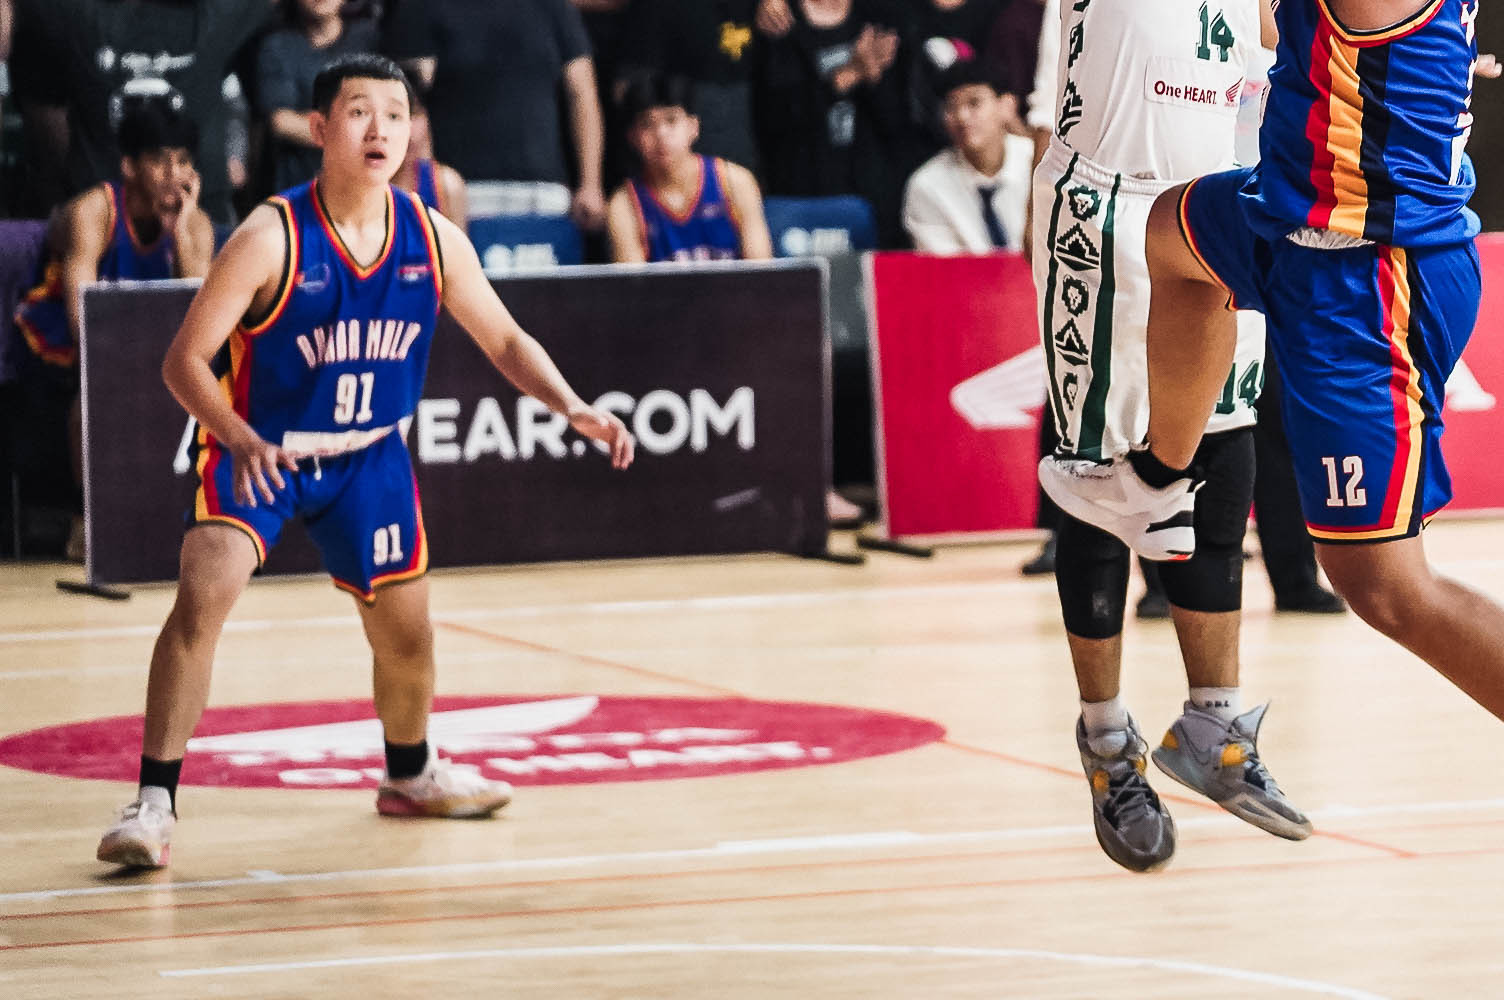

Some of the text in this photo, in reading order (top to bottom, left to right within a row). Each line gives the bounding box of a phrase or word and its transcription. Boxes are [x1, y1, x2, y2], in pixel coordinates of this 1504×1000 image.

[1196, 1, 1235, 63] 14
[1154, 80, 1182, 98] One
[334, 371, 375, 424] 91
[1214, 360, 1265, 425] 14
[1321, 455, 1367, 508] 12
[373, 523, 403, 565] 91
